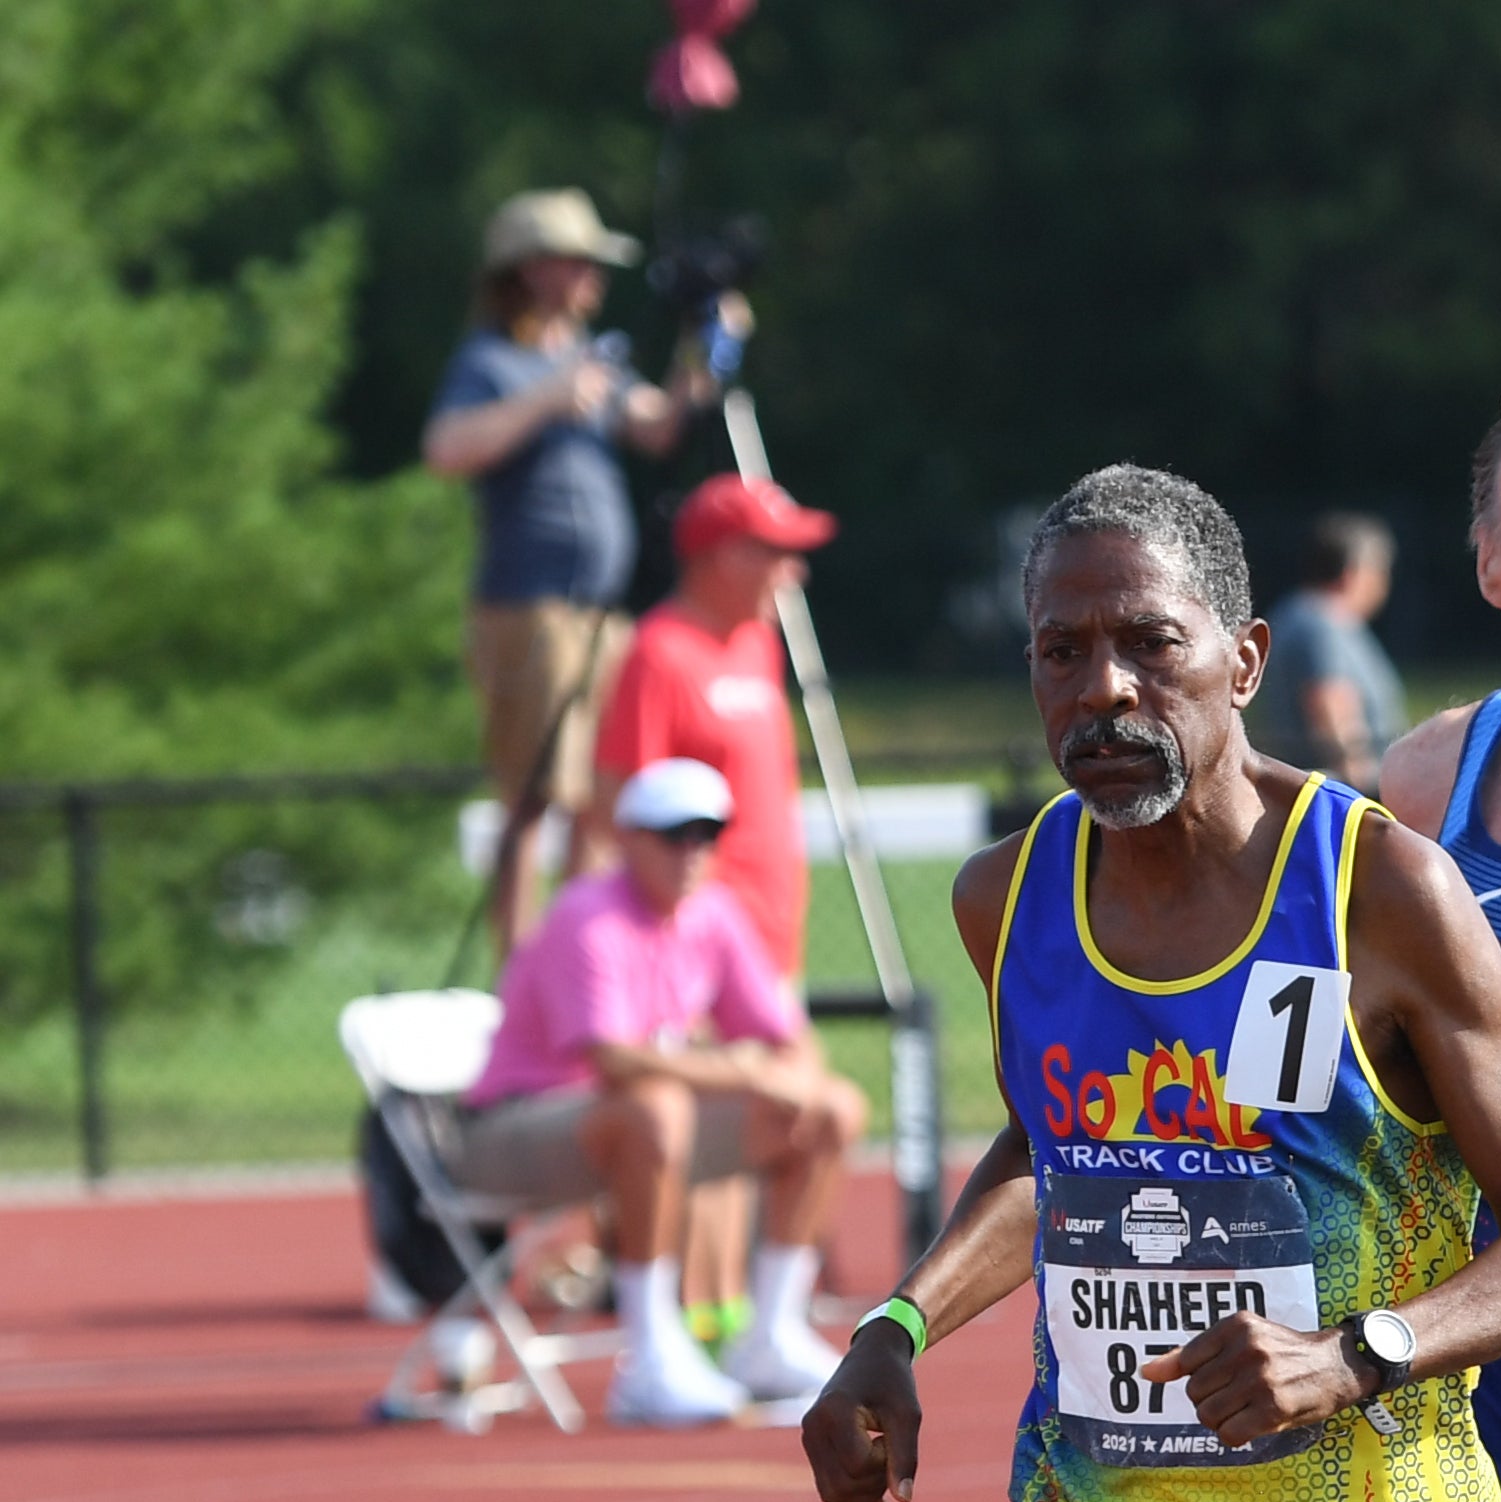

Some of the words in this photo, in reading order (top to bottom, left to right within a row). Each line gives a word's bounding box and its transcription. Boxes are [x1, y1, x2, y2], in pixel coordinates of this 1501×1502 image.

[1268, 975, 1315, 1104] 1
[1055, 1144, 1166, 1173] TRACK
[1177, 1149, 1277, 1176] CLUB
[1065, 1218, 1106, 1234] USATF
[1124, 1221, 1187, 1236] CHAMPIONSHIPS
[1070, 1279, 1267, 1331] SHAHEED
[1102, 1433, 1137, 1453] 2021
[1162, 1436, 1226, 1456] AMES,
